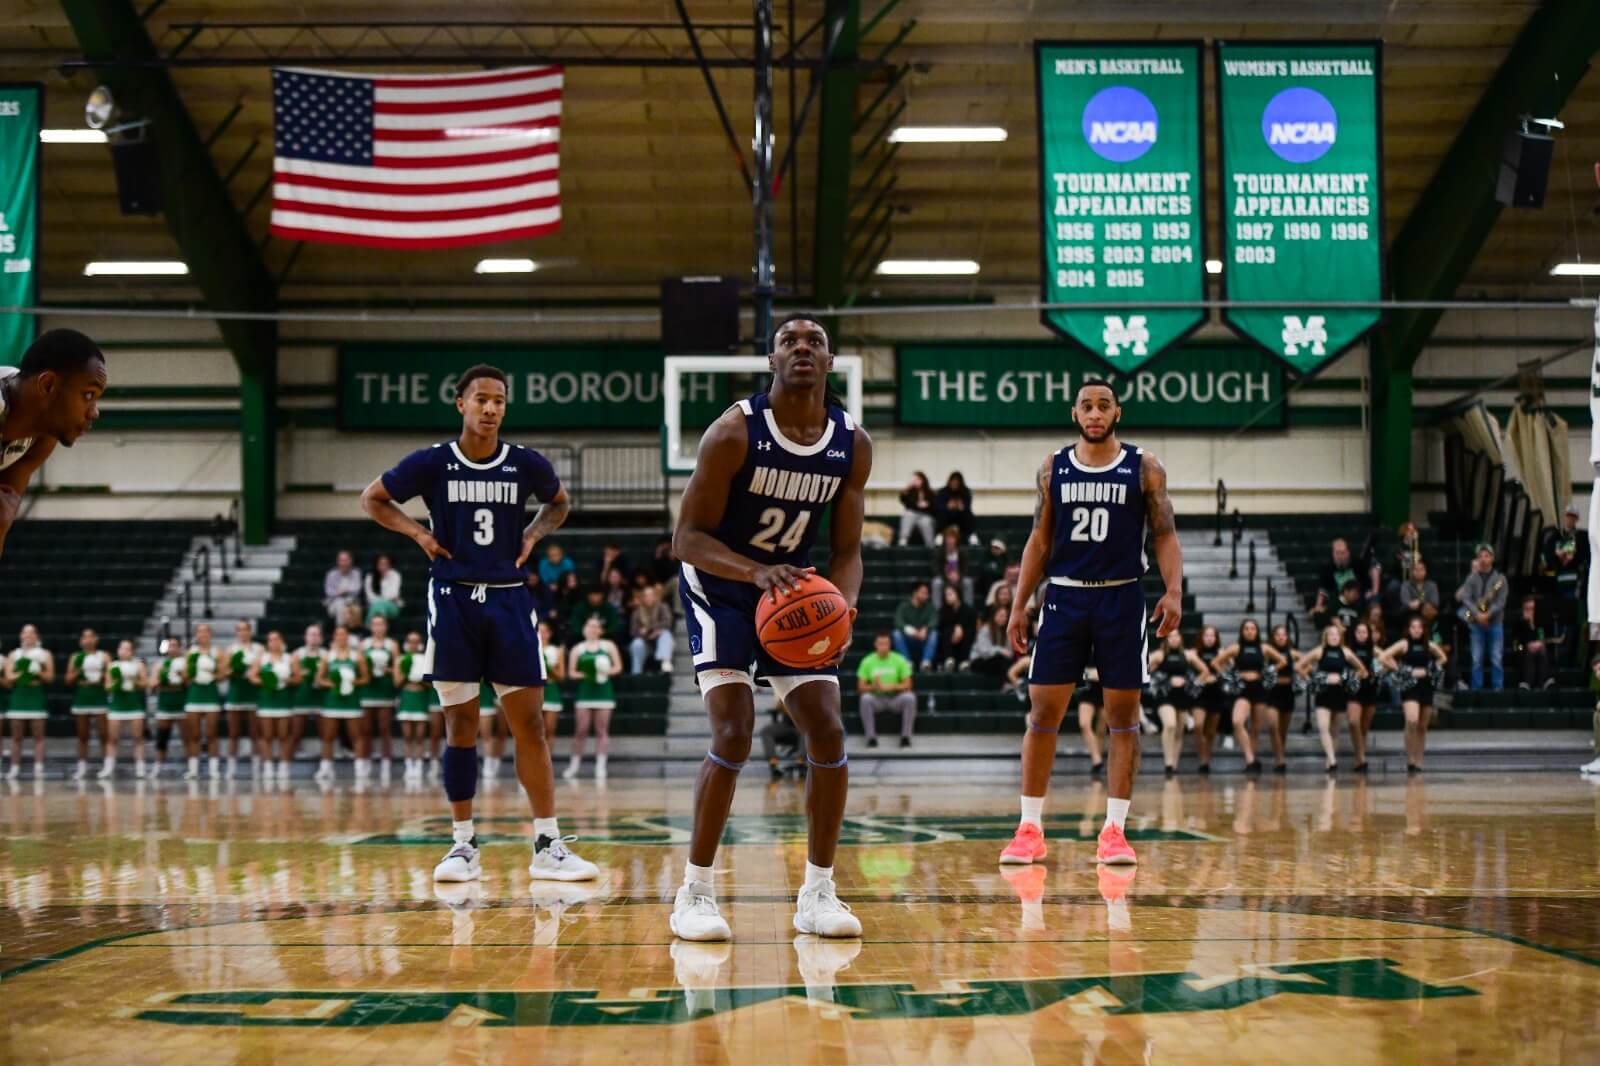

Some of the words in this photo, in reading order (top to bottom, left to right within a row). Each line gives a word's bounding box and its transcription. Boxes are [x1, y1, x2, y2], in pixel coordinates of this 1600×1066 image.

[1055, 59, 1097, 75] MEN'S
[1099, 59, 1184, 75] BASKETBALL
[1223, 60, 1287, 76] WOMEN'S
[1290, 60, 1373, 76] BASKETBALL
[1089, 121, 1157, 143] NCAA
[1270, 122, 1336, 144] NCAA
[1053, 172, 1191, 193] TOURNAMENT
[1233, 173, 1369, 195] TOURNAMENT
[1054, 195, 1191, 216] APPEARANCES
[1233, 197, 1370, 217] APPEARANCES
[356, 373, 430, 403] THE
[913, 370, 987, 402] THE
[997, 371, 1071, 402] 6TH
[1083, 371, 1270, 403] OROUGH
[826, 449, 846, 459] CAA
[447, 480, 518, 505] MONMOUTH
[748, 466, 842, 503] MONMOUTH
[1060, 482, 1127, 505] MONMOUTH
[473, 508, 495, 546] 3
[749, 507, 812, 553] 24
[1070, 507, 1109, 543] 20
[775, 606, 811, 632] ROCK
[811, 599, 836, 622] THE
